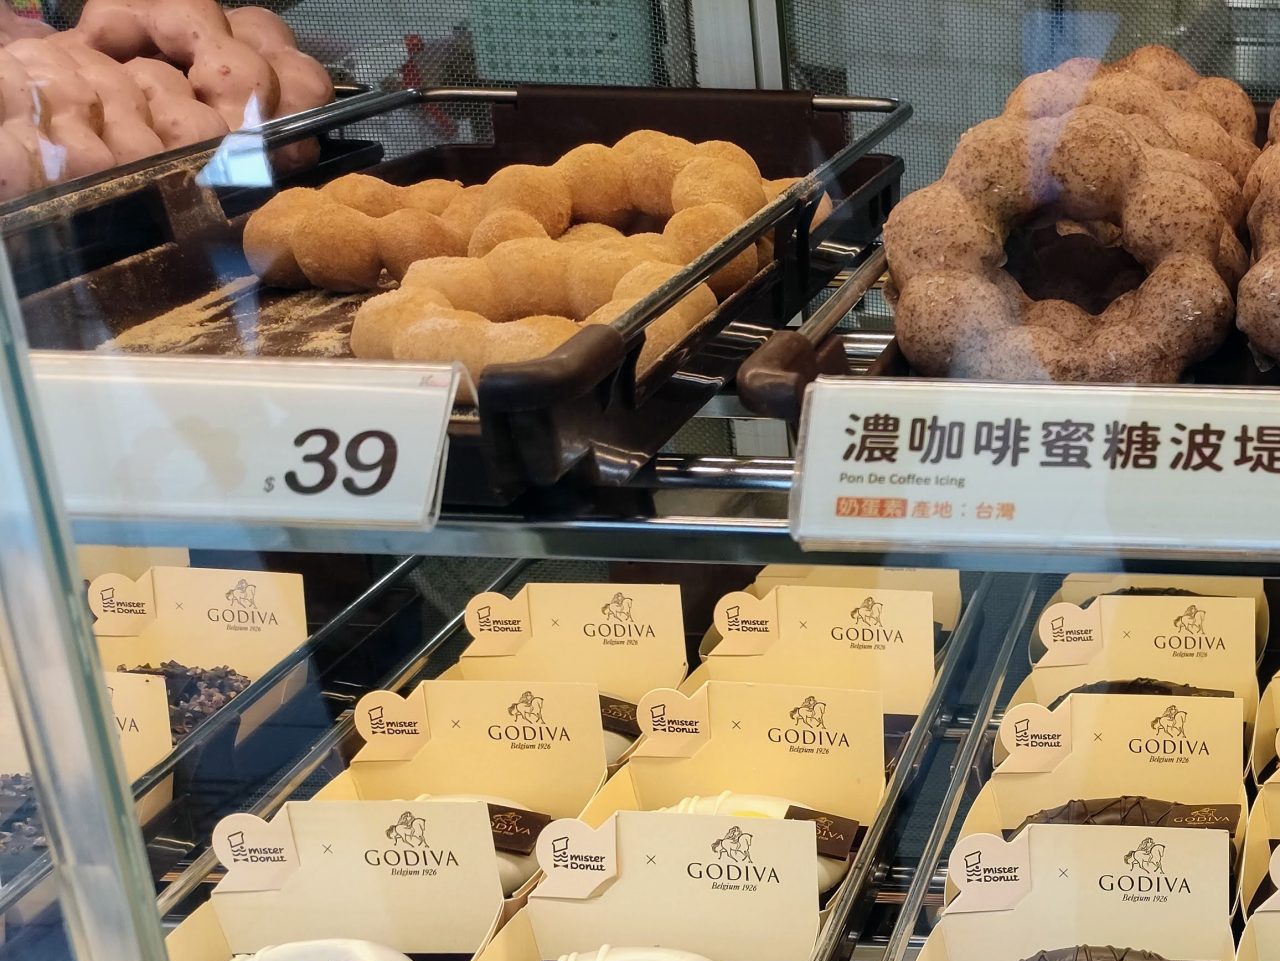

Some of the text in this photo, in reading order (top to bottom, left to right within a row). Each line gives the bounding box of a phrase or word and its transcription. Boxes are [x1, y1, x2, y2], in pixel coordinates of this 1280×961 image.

[839, 472, 965, 488] Pon De Coffee Icing
[838, 498, 904, 517] 奶蛋素
[207, 608, 279, 626] GODIVA
[583, 623, 656, 638] GODIVA
[831, 626, 904, 644] GODIVA
[1154, 636, 1226, 651] GODIVA
[488, 725, 571, 742] GODIVA
[768, 728, 850, 748] GODIVA
[510, 742, 536, 750] Belgium
[789, 745, 814, 754] Belgium
[1128, 738, 1210, 756] GODIVA
[1150, 755, 1175, 763] Belgium
[1174, 815, 1230, 823] GODIVA
[364, 849, 459, 867] GODIVA
[391, 868, 437, 876] Belgium 1926
[687, 862, 780, 884] GODIVA
[711, 882, 757, 892] Belgium 1926
[1099, 874, 1191, 894] GODIVA
[1122, 894, 1168, 903] Belgium 1926
